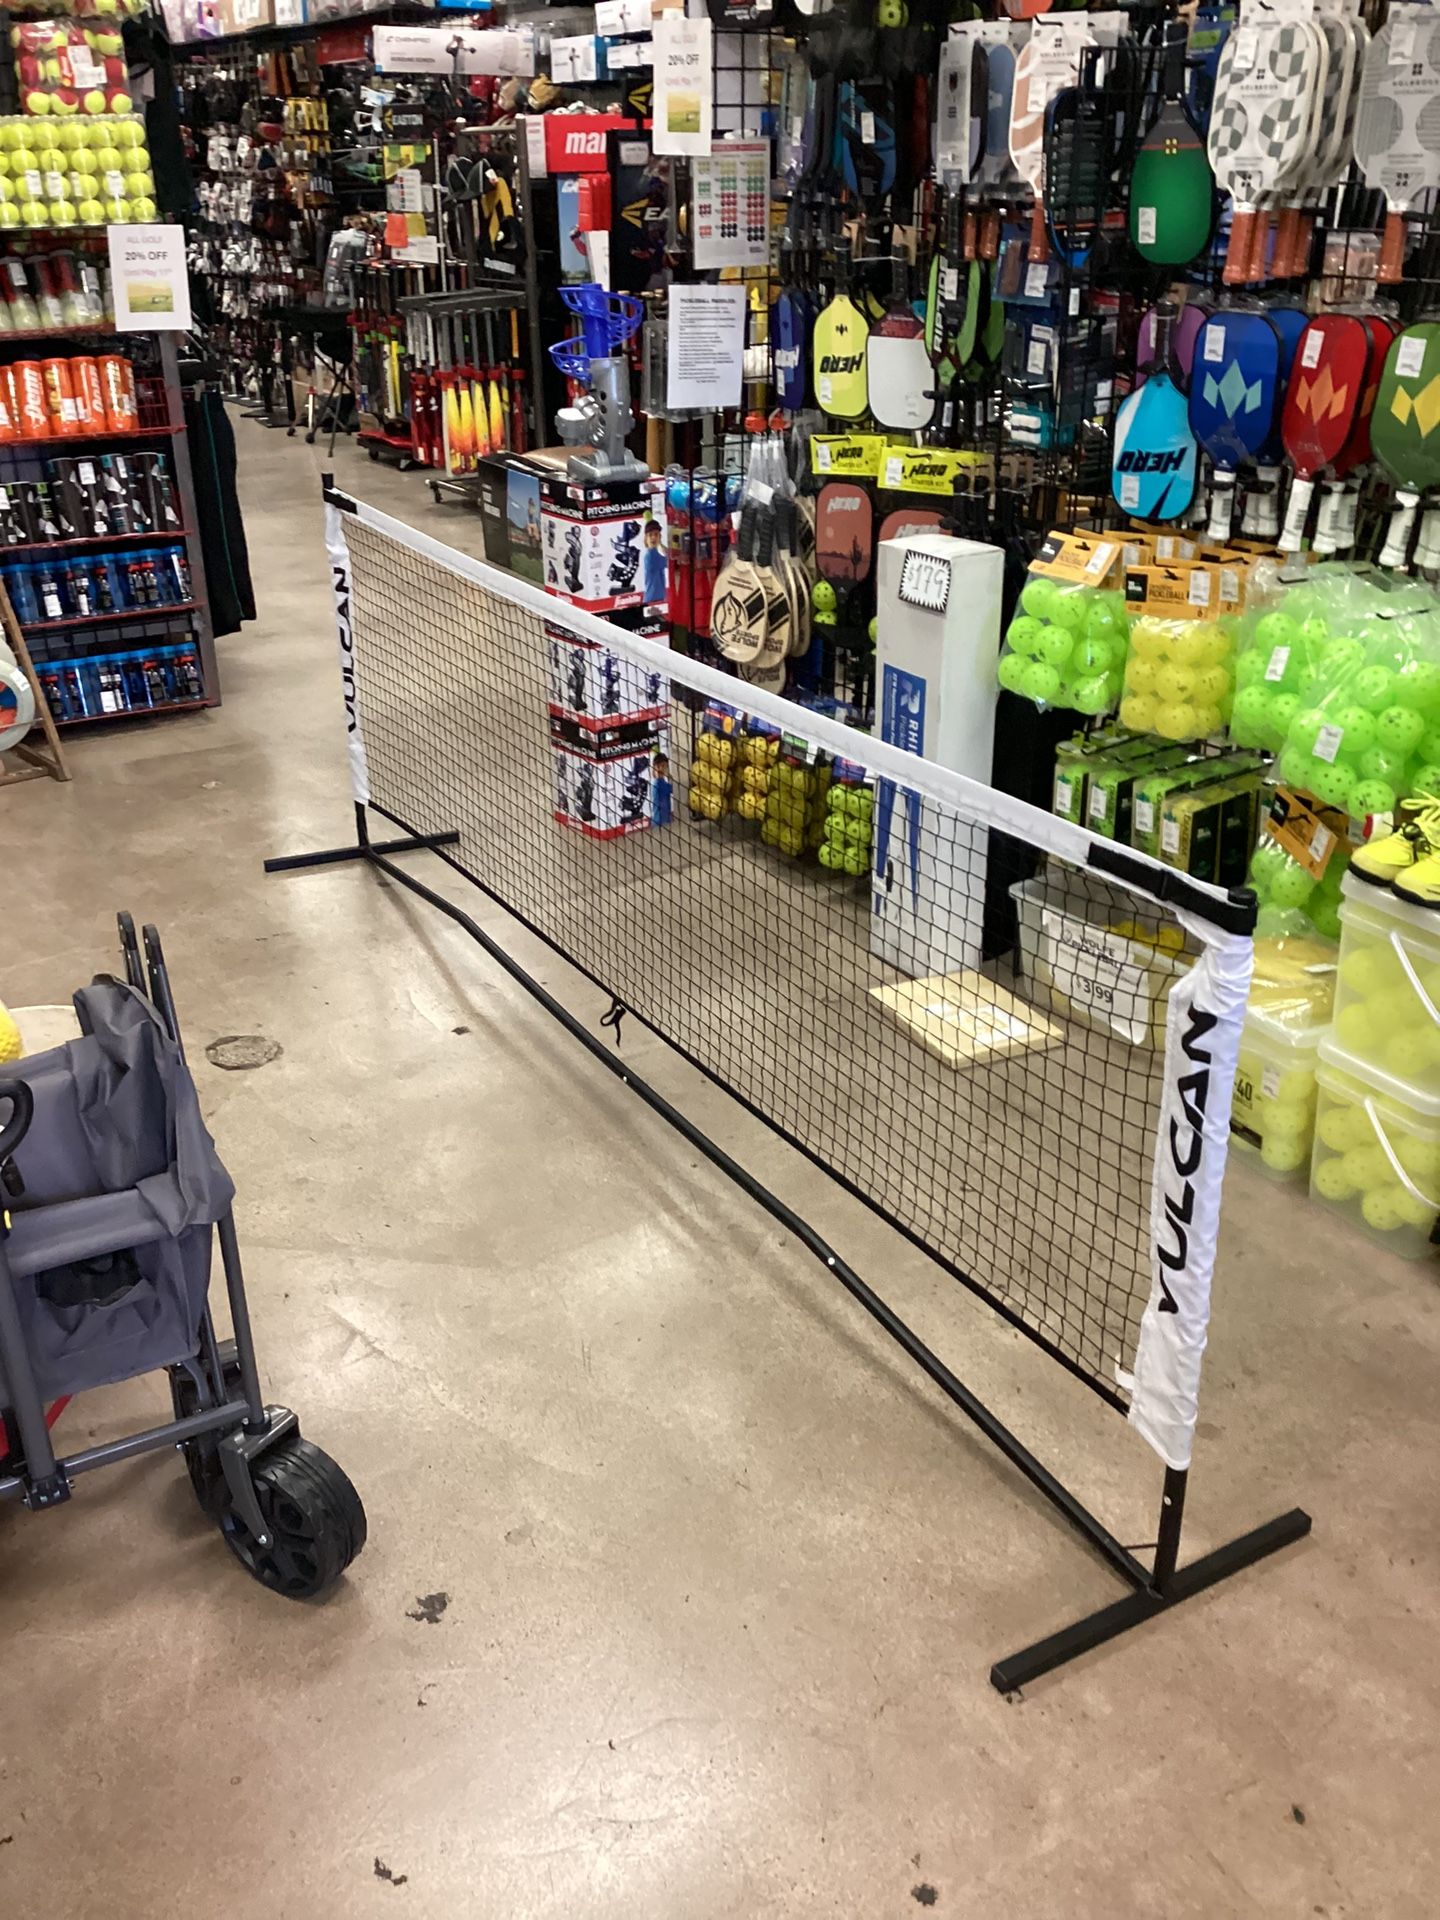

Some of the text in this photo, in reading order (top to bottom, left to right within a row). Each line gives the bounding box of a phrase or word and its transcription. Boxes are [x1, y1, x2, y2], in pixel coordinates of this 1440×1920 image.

[125, 251, 169, 261] 20% OFF
[819, 351, 865, 374] HERO
[836, 446, 864, 462] HERO
[1115, 446, 1188, 475] HERO
[909, 463, 948, 478] HERO
[586, 499, 653, 516] PITCHING MACHINE
[827, 497, 862, 516] HERO
[333, 567, 357, 733] VULCAN
[731, 634, 758, 648] WOLFE
[1157, 1003, 1218, 1314] VULCAN
